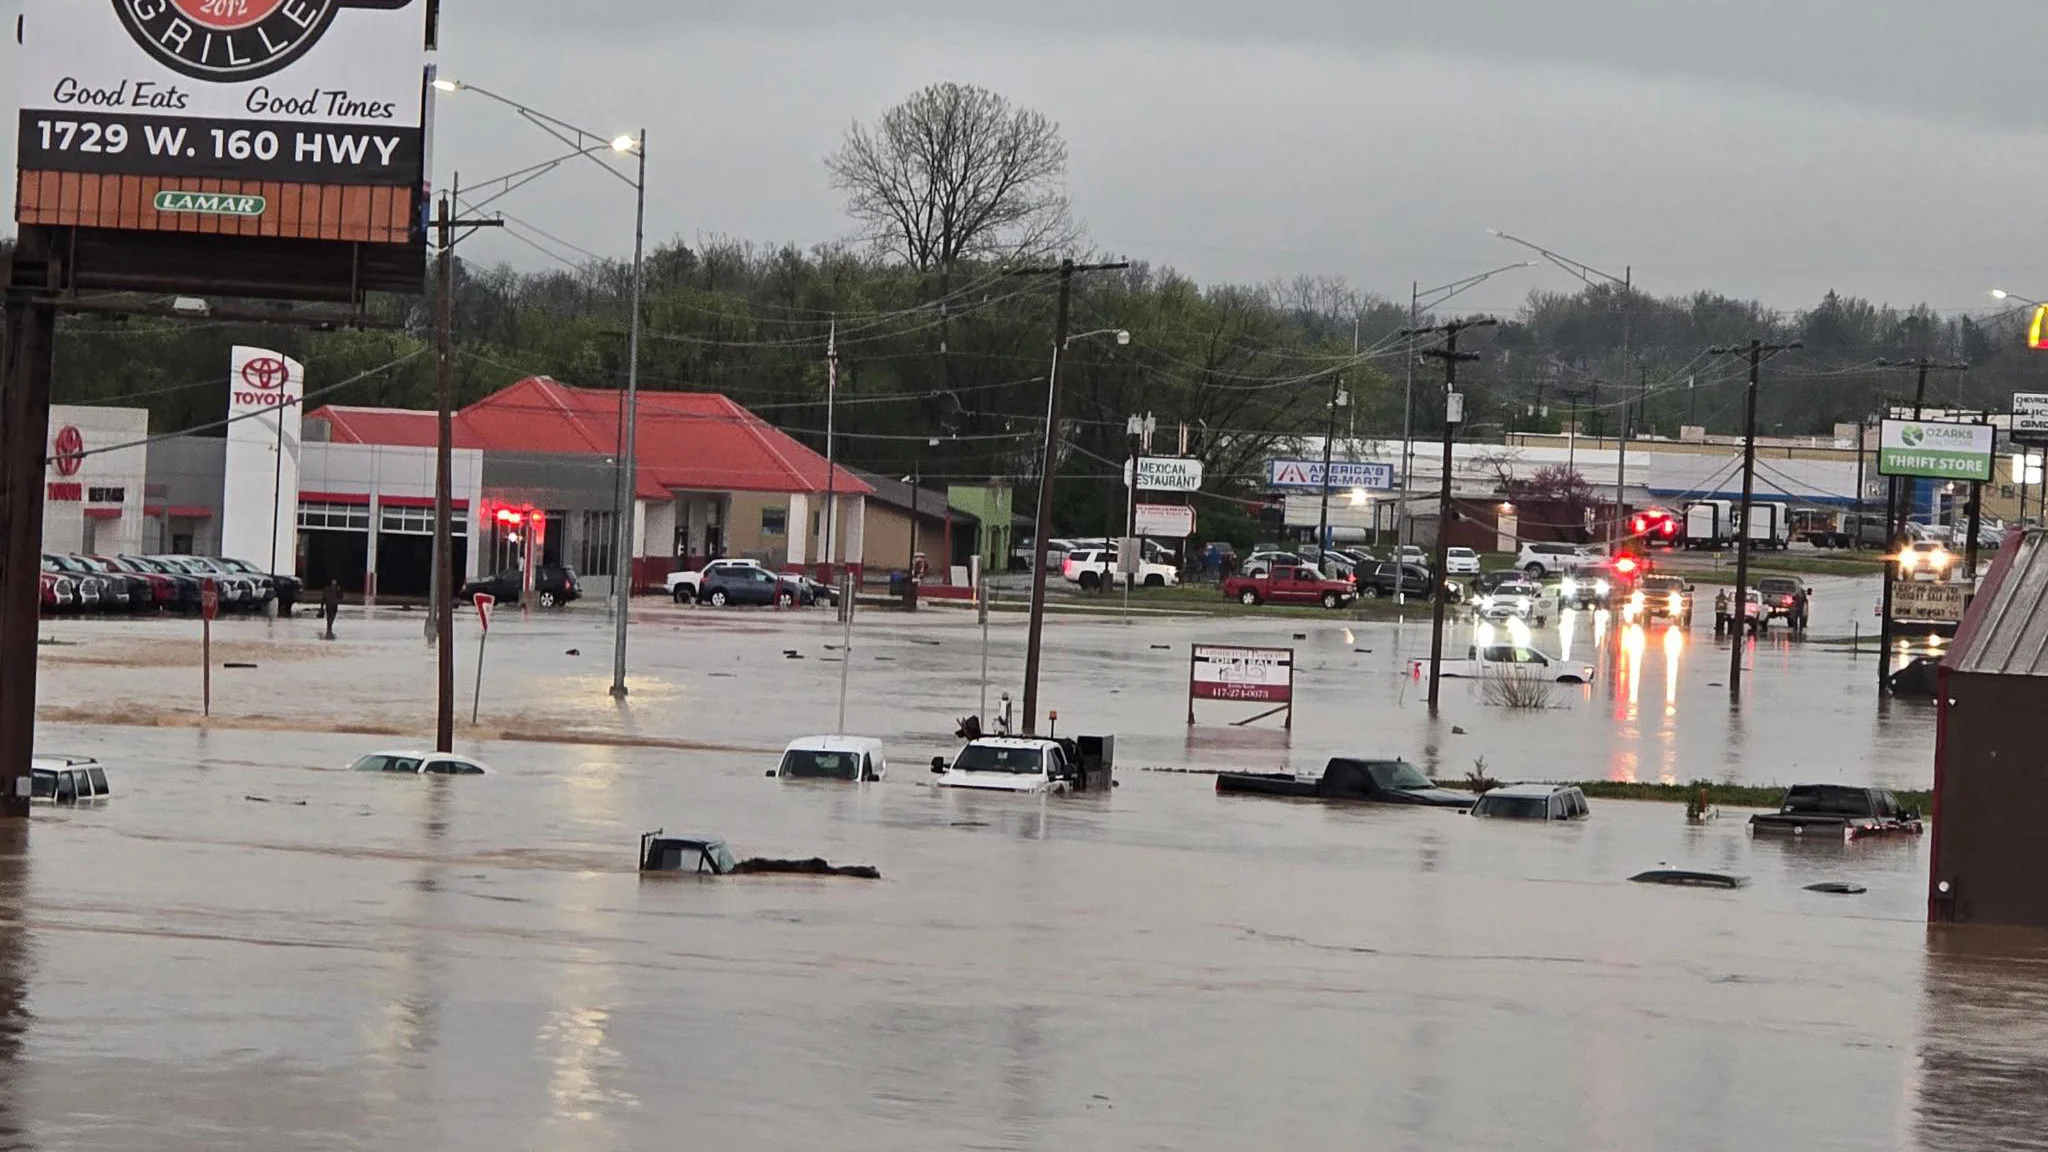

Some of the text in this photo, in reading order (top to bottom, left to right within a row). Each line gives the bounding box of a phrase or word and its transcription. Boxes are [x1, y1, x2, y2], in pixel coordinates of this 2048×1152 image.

[200, 0, 248, 17] 2012
[133, 0, 317, 65] GRILLE
[53, 77, 396, 119] Good Eats Good Times
[38, 121, 400, 166] 1729 W. 160 HWY
[163, 193, 255, 213] LAMAR
[234, 391, 296, 407] TOYOTA
[1926, 428, 1973, 439] OZARKS
[1140, 461, 1186, 474] MEXICAN
[1888, 454, 1983, 472] THRIFT STORE
[1136, 474, 1197, 487] ESTAURANT
